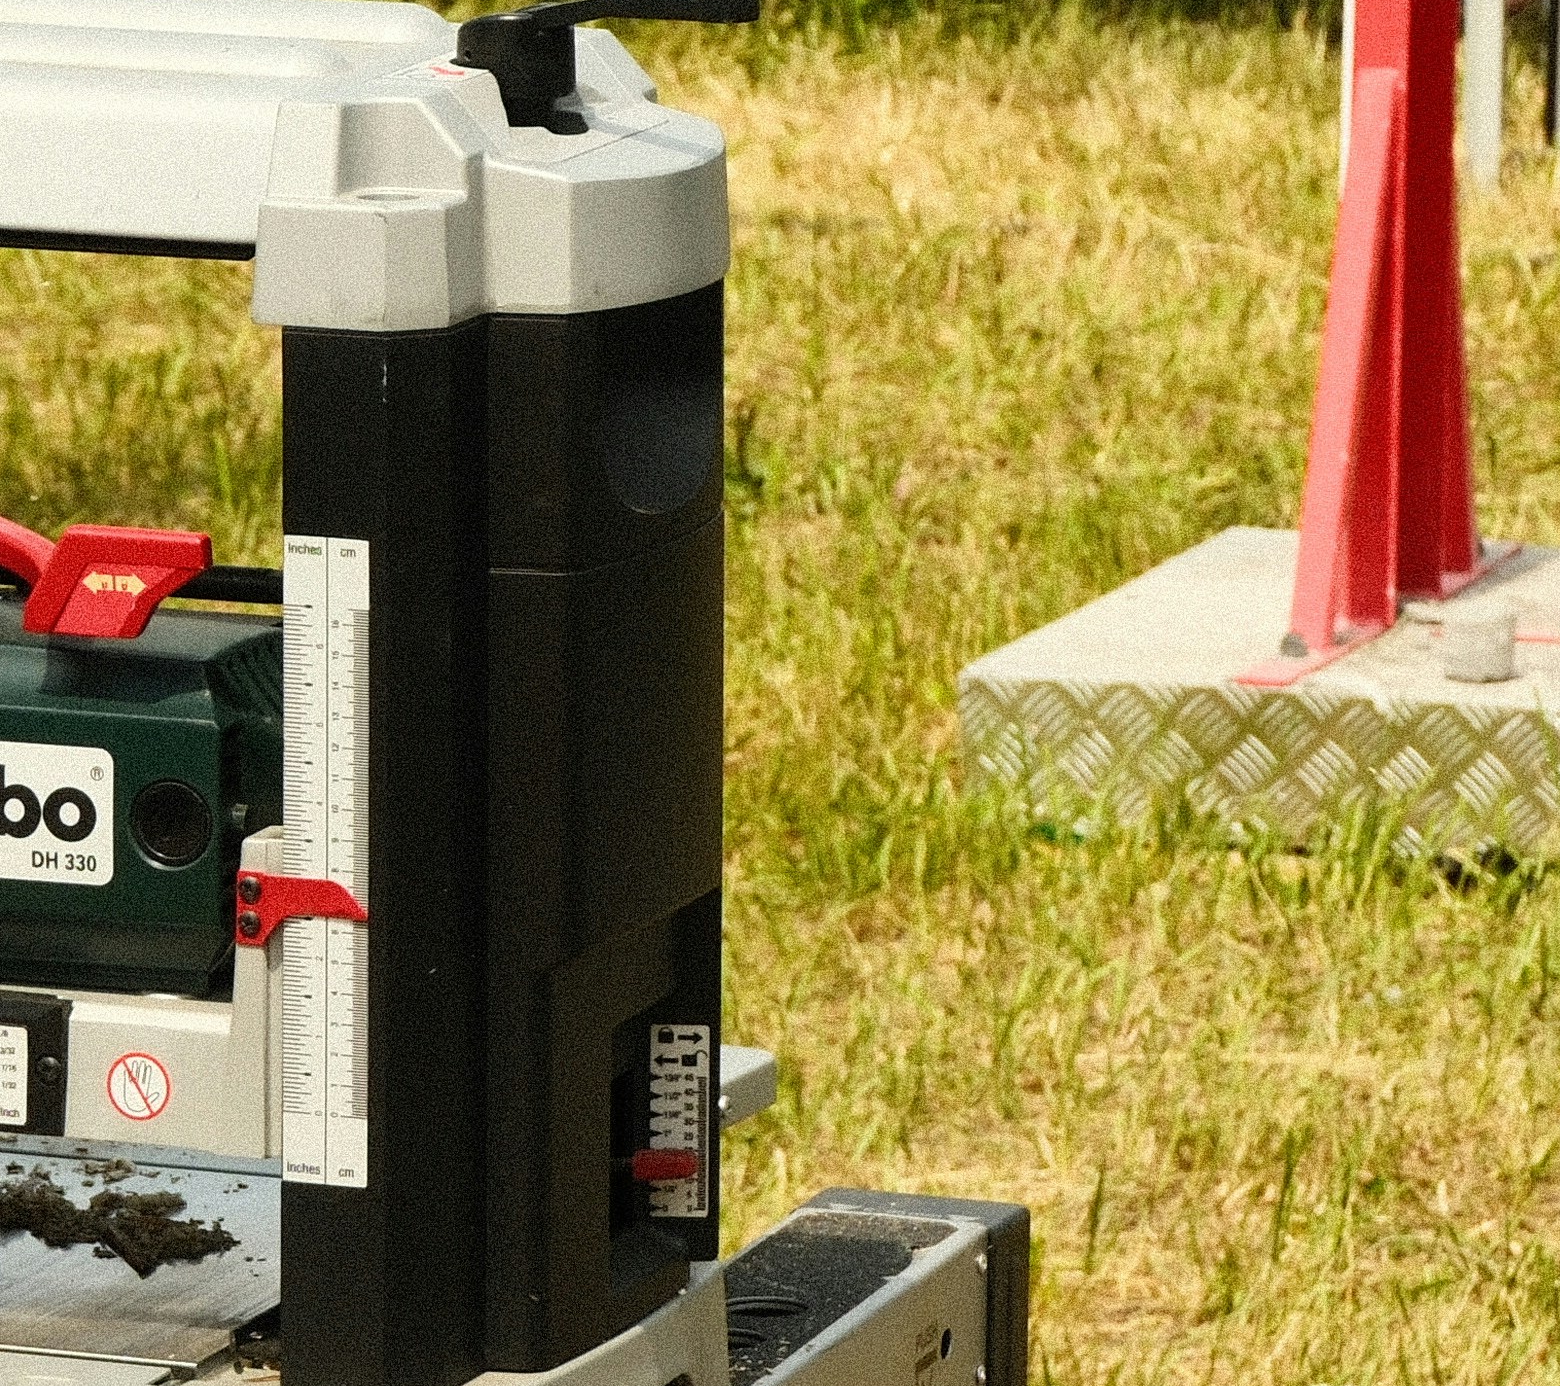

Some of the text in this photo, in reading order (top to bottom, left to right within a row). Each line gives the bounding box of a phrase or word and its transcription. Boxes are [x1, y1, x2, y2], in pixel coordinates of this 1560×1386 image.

[339, 547, 357, 558] cm
[30, 849, 98, 873] DH 330
[338, 1166, 355, 1178] cm
